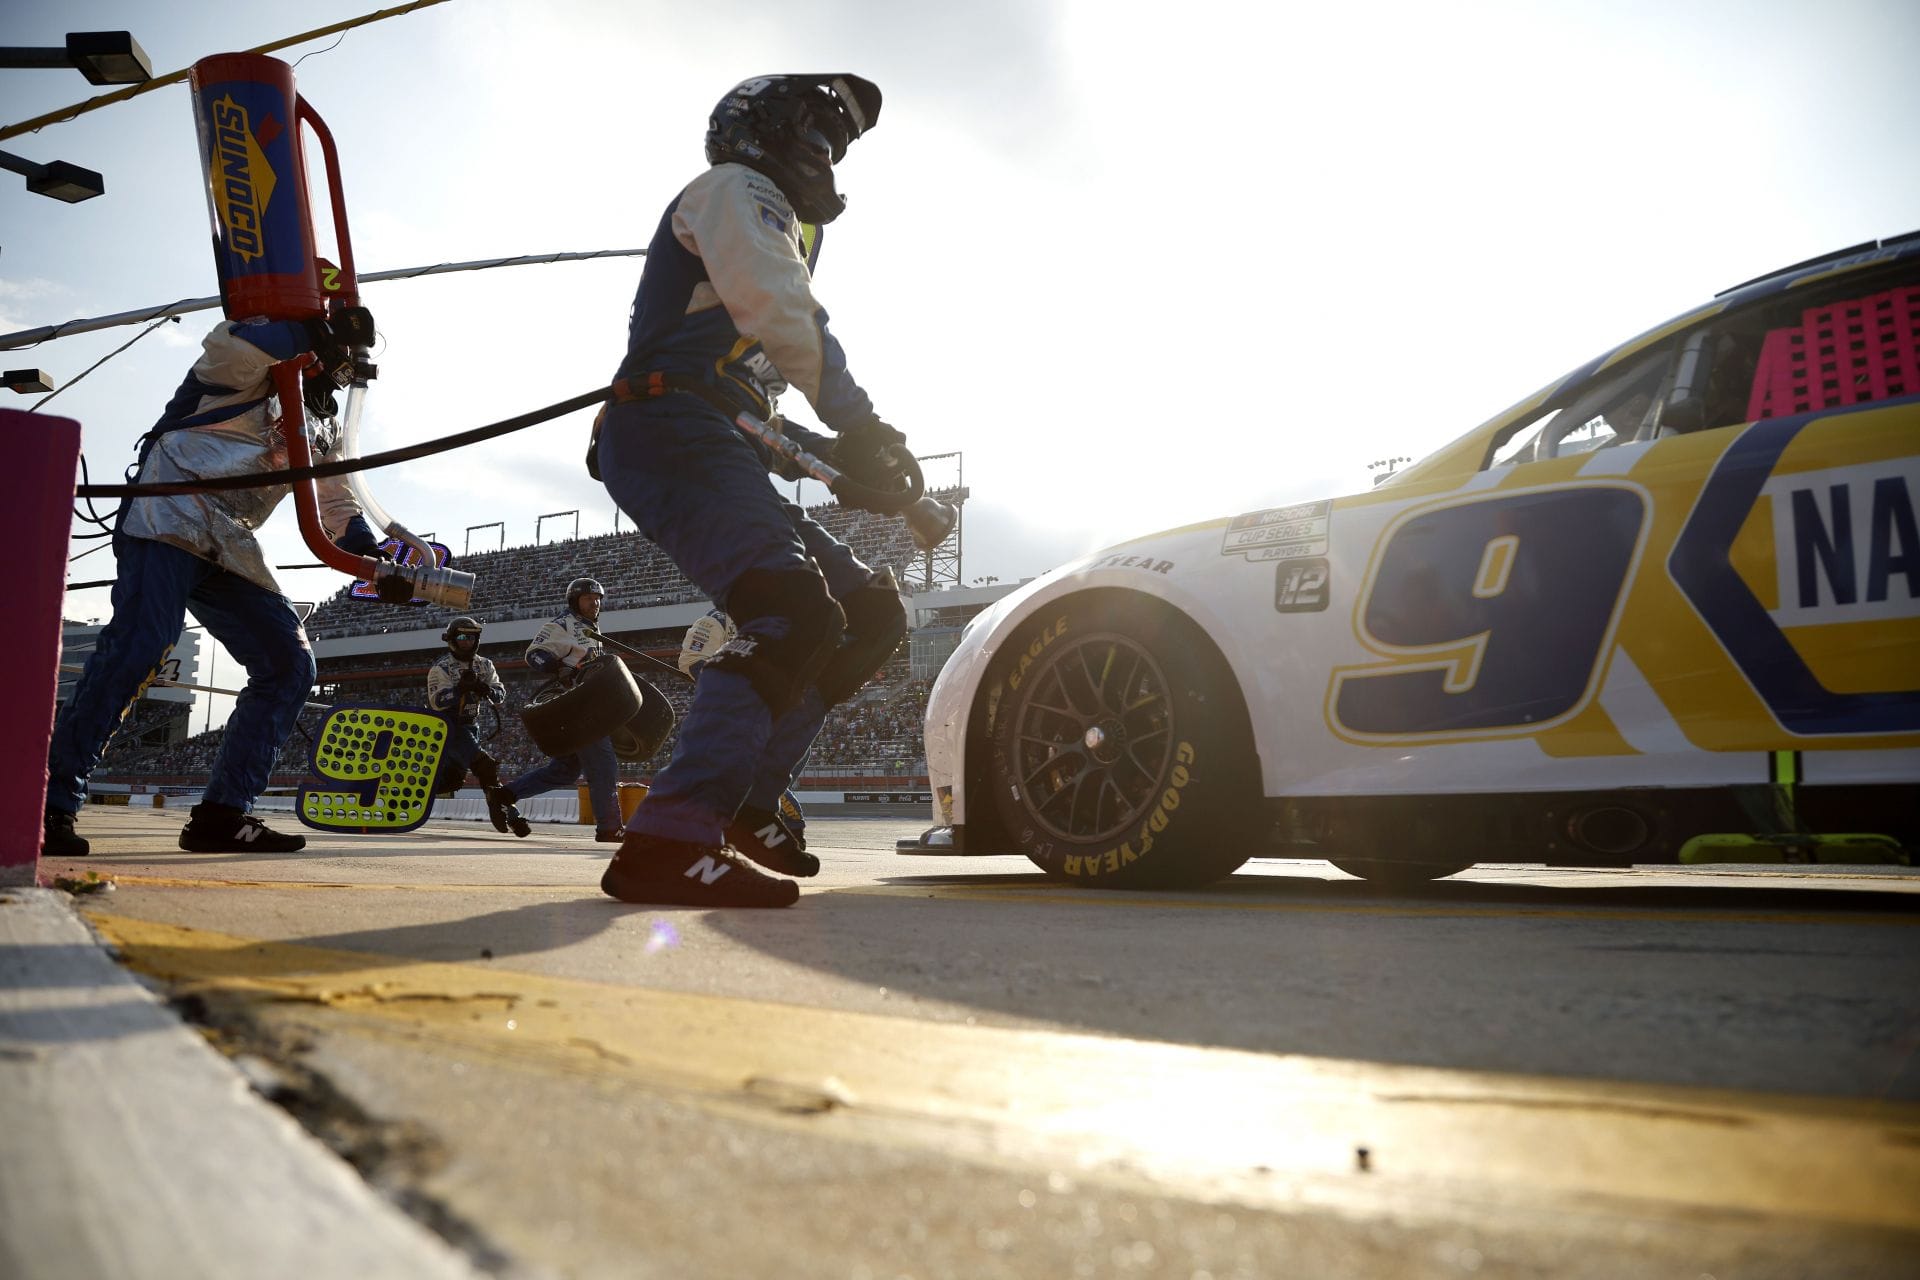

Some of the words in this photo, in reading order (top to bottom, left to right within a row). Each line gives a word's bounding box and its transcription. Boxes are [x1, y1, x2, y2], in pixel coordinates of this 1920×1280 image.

[216, 102, 259, 255] SUNOCO
[321, 267, 341, 291] 2
[1260, 505, 1317, 524] NASCAR
[1238, 530, 1268, 544] CUP
[1268, 522, 1314, 541] SERIES
[1791, 475, 1920, 609] NA
[1261, 545, 1312, 559] PLAYOFFS
[1279, 567, 1329, 605] 12
[1327, 479, 1652, 744] 9
[1009, 615, 1069, 690] EAGLE
[301, 708, 450, 828] 9
[1063, 741, 1195, 876] GOODYEAR
[234, 824, 264, 843] N
[753, 823, 788, 849] N
[683, 855, 731, 886] N
